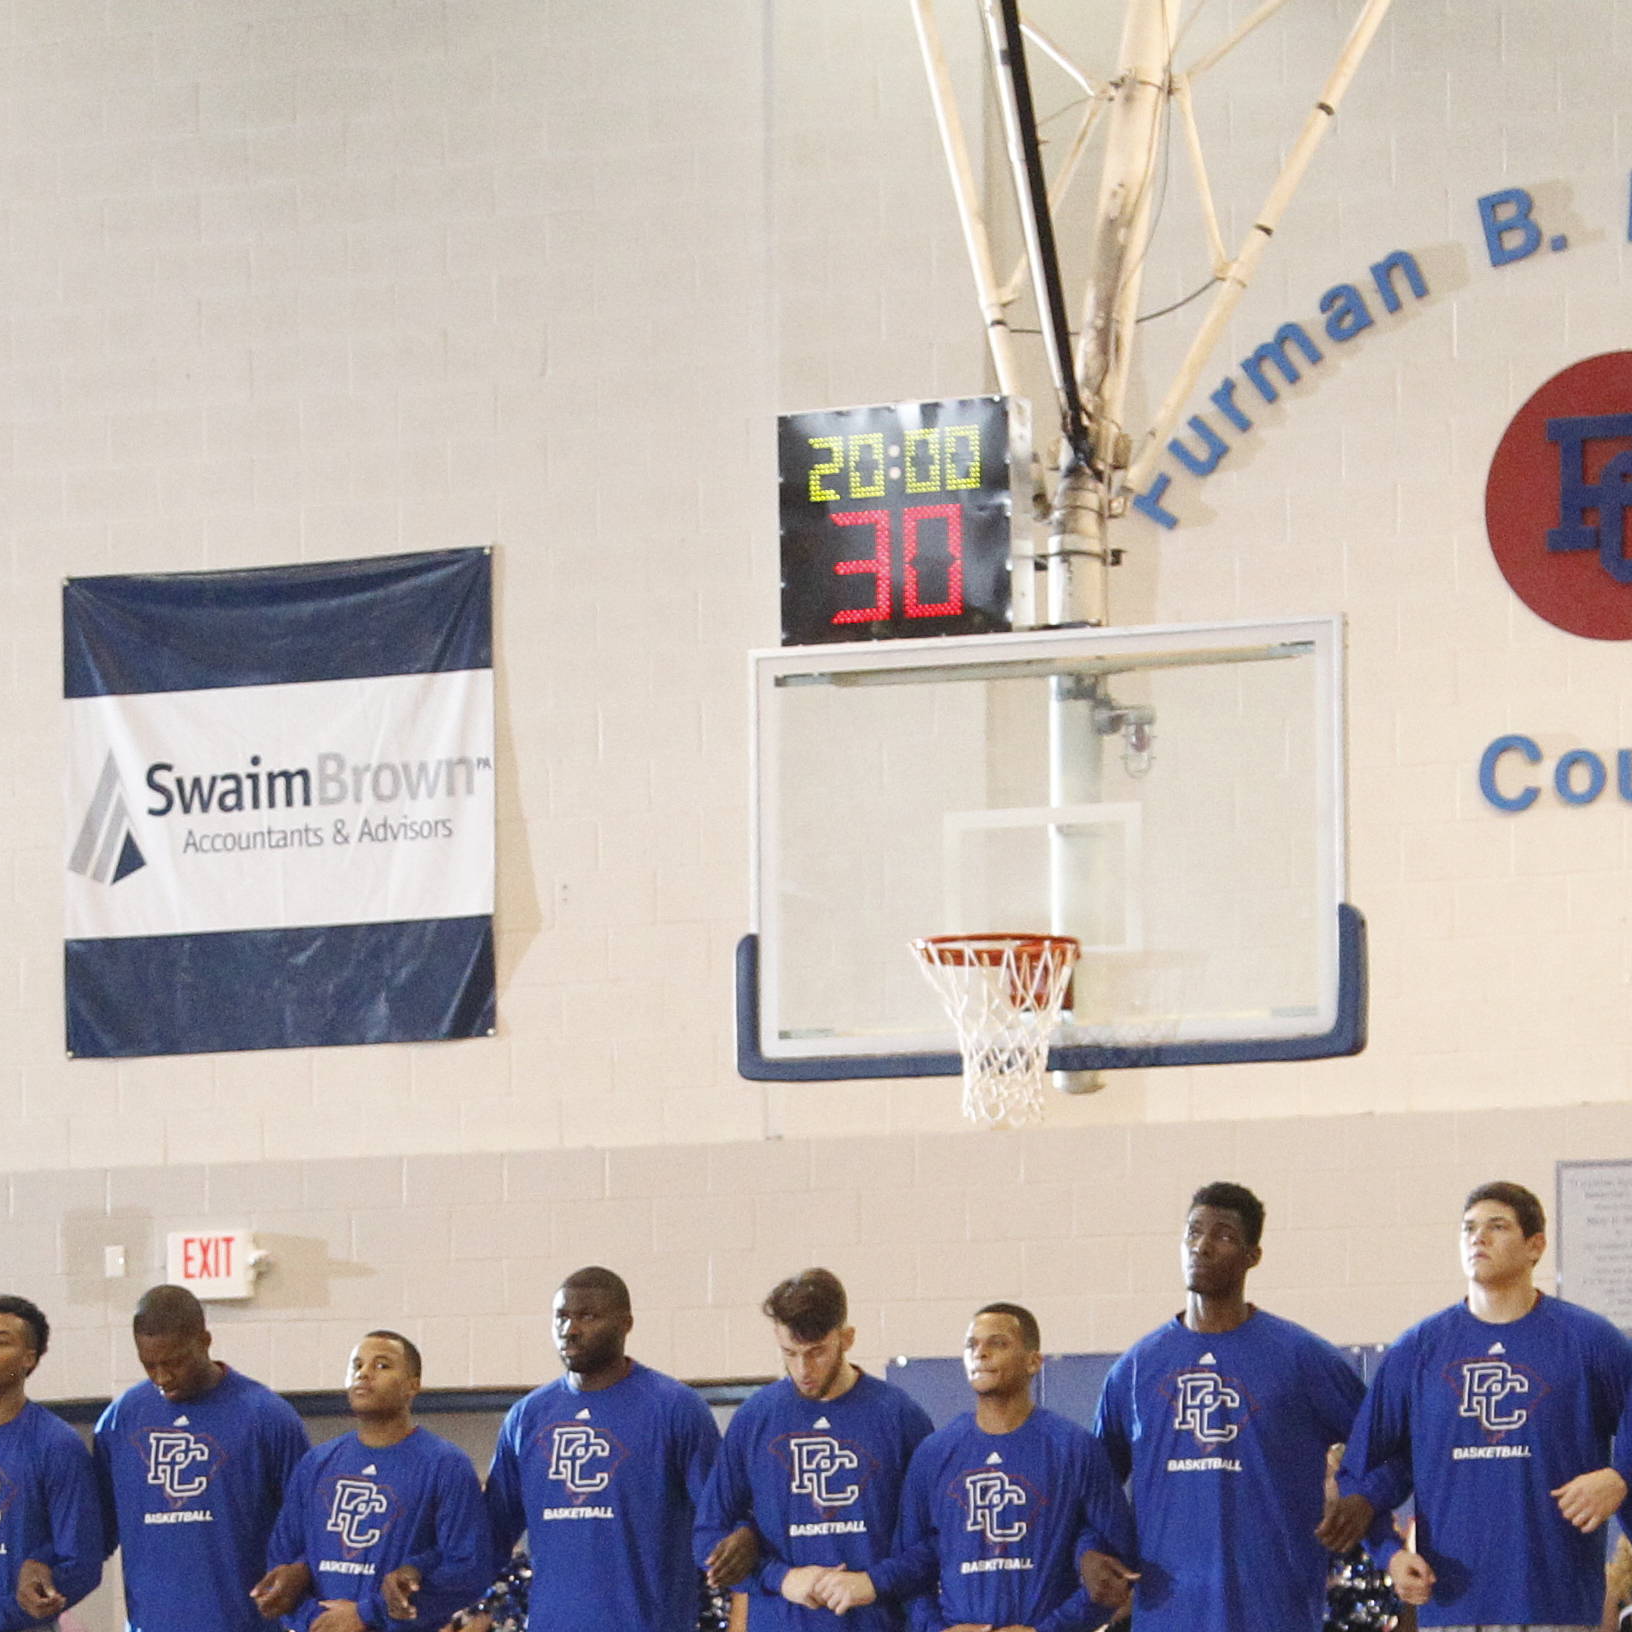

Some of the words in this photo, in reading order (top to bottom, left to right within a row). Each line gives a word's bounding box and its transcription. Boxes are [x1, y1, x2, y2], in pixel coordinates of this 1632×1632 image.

[1477, 187, 1568, 267] B.
[807, 424, 982, 502] 20:00
[829, 503, 964, 625] 30
[183, 823, 324, 855] Accountants
[333, 819, 350, 845] &
[358, 815, 453, 843] Advisors
[183, 1237, 235, 1279] EXIT
[1174, 1372, 1240, 1443] PC
[1458, 1361, 1529, 1431] PC
[147, 1432, 210, 1498] PC
[547, 1427, 611, 1494] PC
[789, 1436, 860, 1507] PC
[1166, 1456, 1243, 1473] BASKETBALL
[1452, 1445, 1532, 1461] BASKETBALL
[143, 1509, 214, 1525] BASKETBALL
[325, 1479, 388, 1549] PC
[542, 1506, 615, 1521] BASKETBALL
[789, 1519, 867, 1538] BASKETBALL
[965, 1471, 1027, 1543] PC
